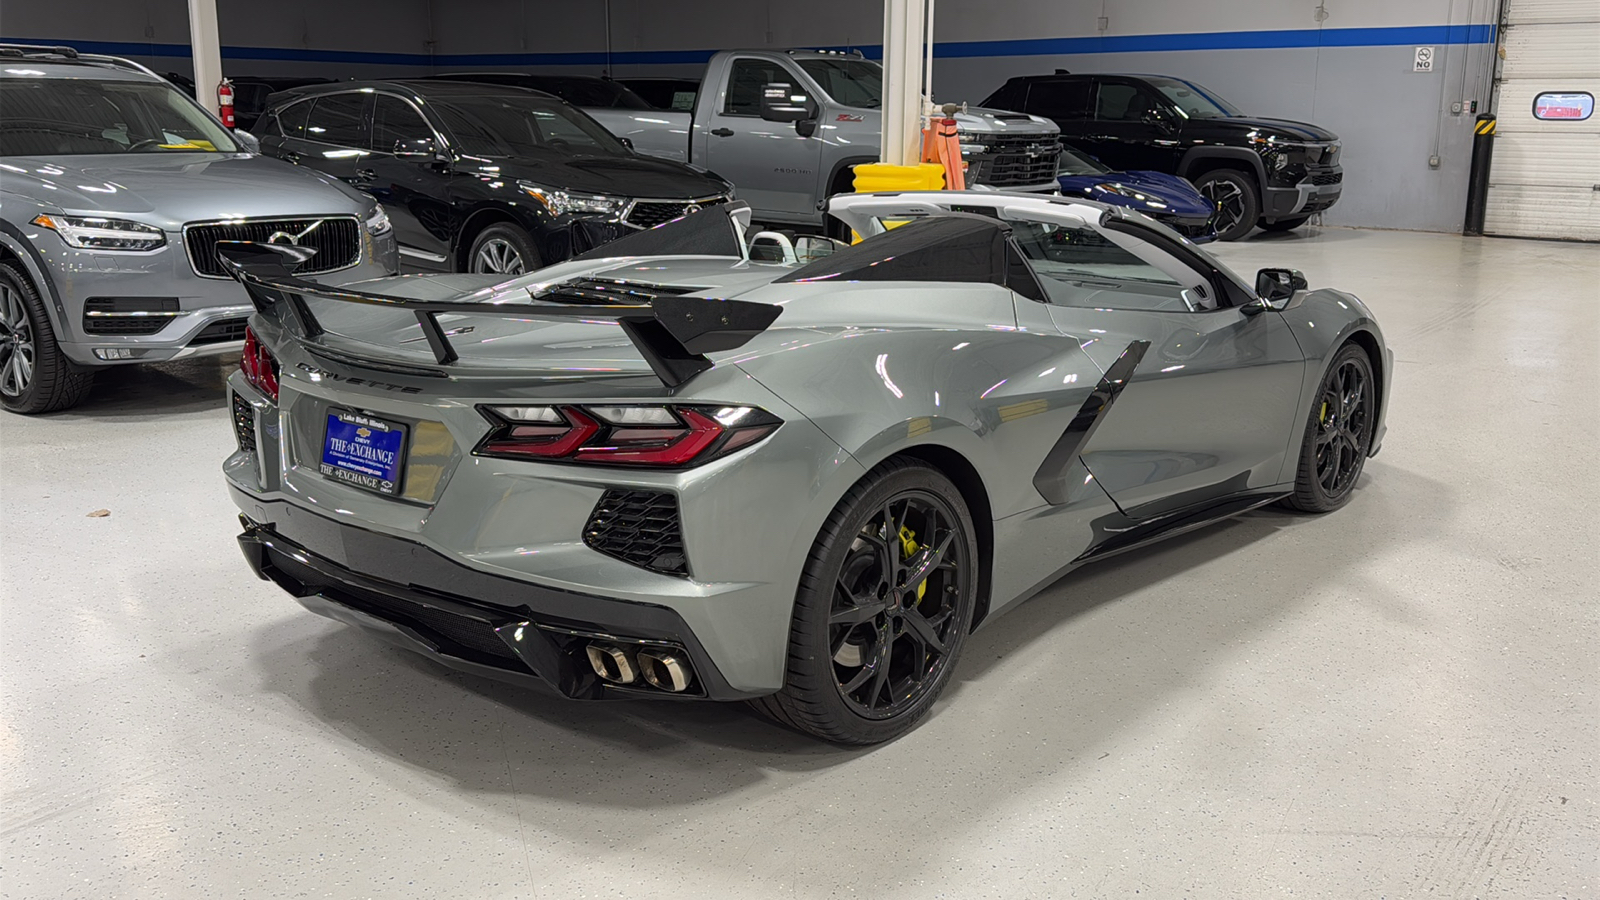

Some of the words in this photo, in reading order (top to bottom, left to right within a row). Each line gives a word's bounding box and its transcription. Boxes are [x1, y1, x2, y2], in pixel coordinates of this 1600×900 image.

[296, 362, 423, 395] CORVETTE
[344, 413, 354, 422] Lake
[330, 437, 348, 453] THE
[350, 442, 394, 464] EXCHANGE
[354, 436, 370, 444] CHEVY
[320, 464, 334, 476] THE
[338, 469, 378, 489] EXCHANGE
